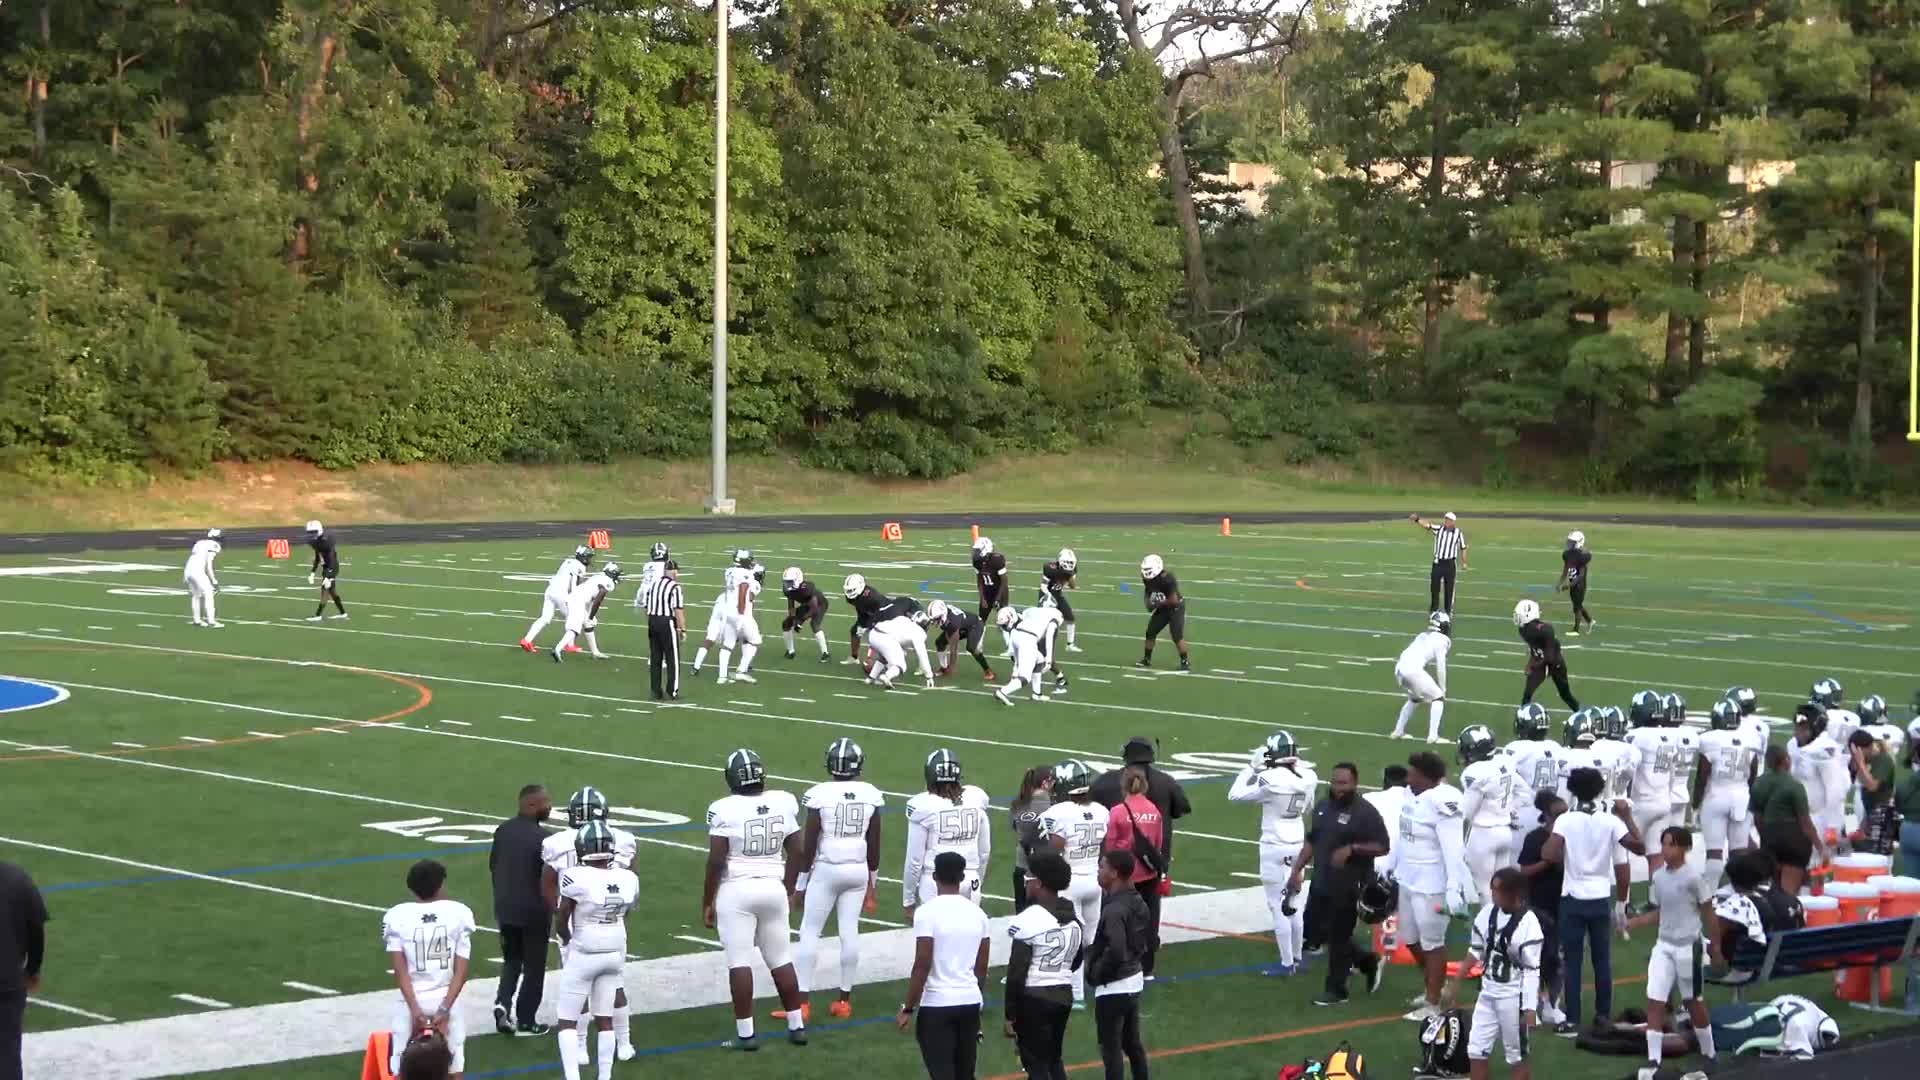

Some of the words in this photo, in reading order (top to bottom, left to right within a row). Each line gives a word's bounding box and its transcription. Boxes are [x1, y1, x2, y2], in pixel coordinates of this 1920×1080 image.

[271, 540, 289, 558] 20
[743, 815, 784, 857] 66
[834, 801, 865, 838] 19
[937, 808, 978, 844] 50
[412, 925, 451, 972] 14
